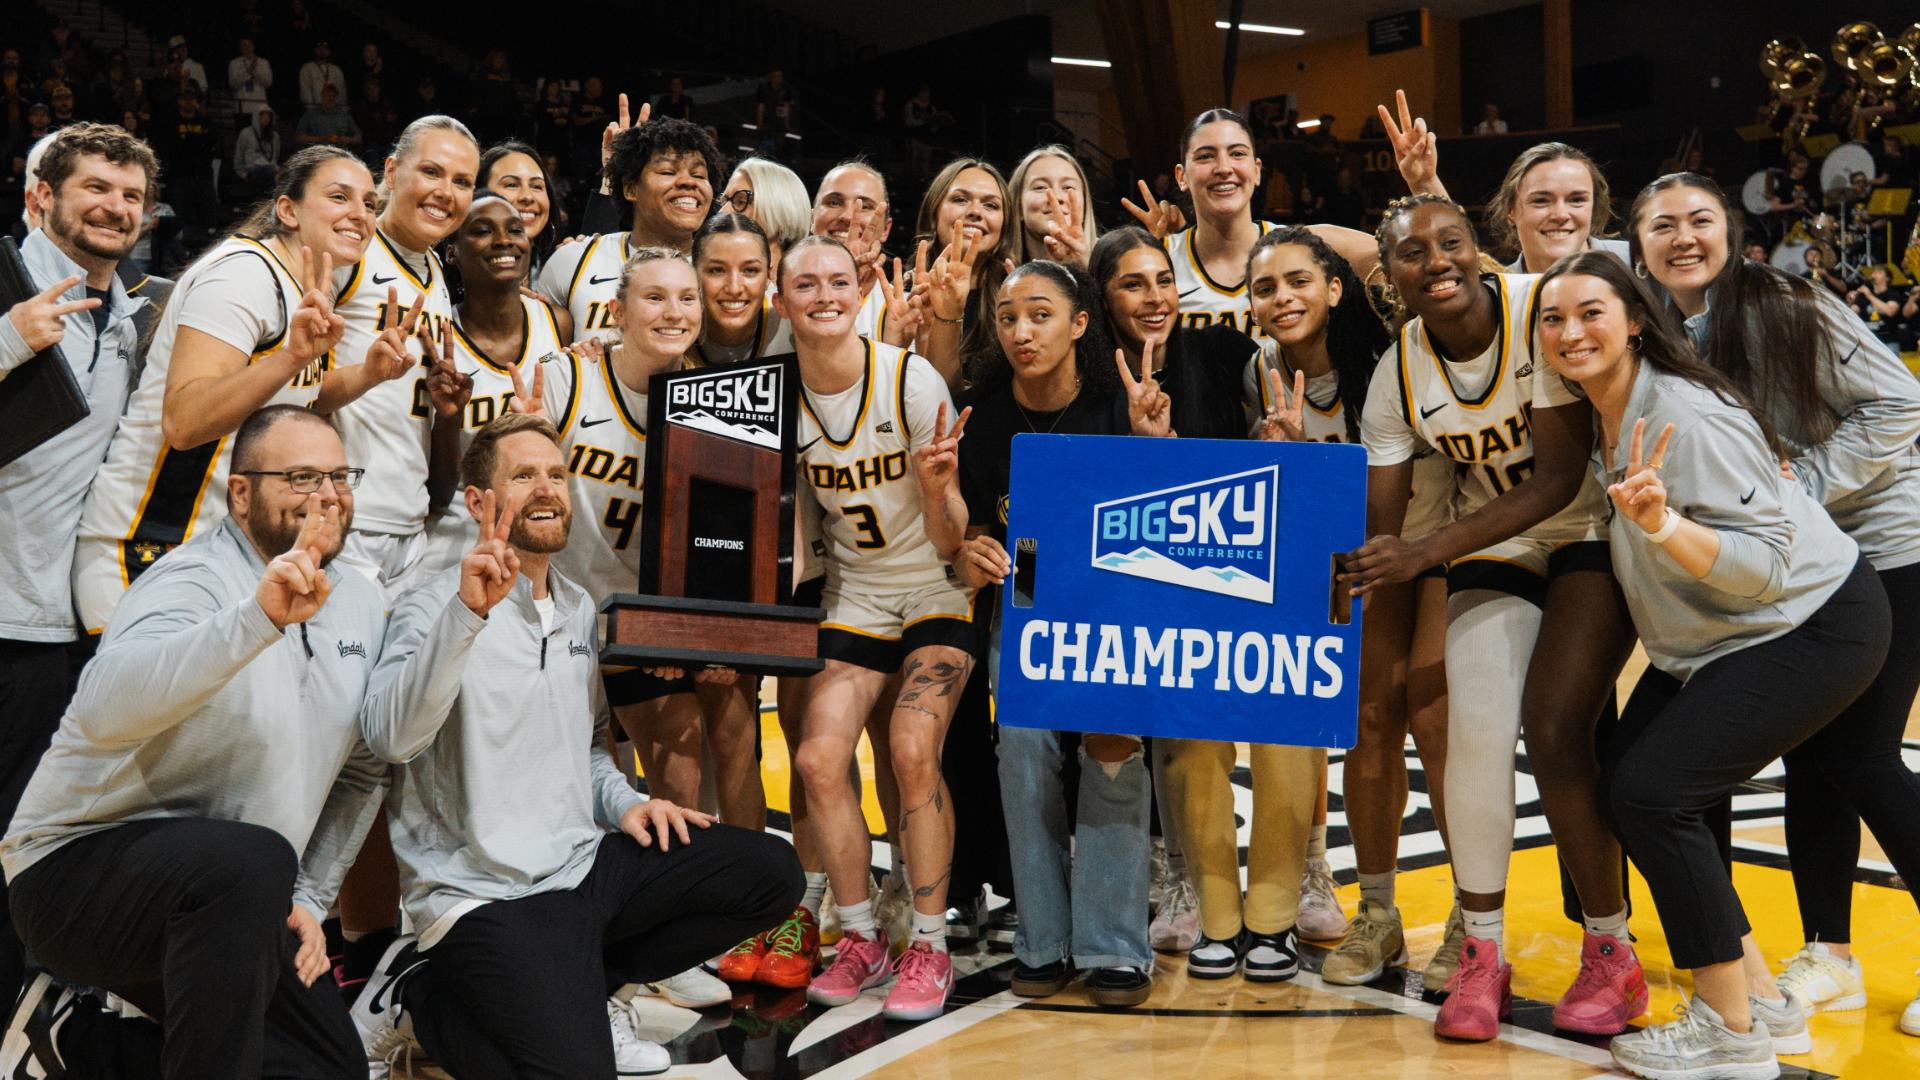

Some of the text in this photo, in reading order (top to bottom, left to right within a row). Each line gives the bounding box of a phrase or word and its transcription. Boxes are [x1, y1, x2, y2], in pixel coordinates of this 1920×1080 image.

[1362, 150, 1398, 172] 10
[715, 410, 775, 422] CONFERENCE
[568, 444, 644, 491] IDA
[604, 497, 642, 550] 4
[841, 504, 887, 549] 3
[694, 537, 745, 550] CHAMPIONS
[1168, 546, 1264, 560] CONFERENCE
[1019, 619, 1344, 699] CHAMPIONS
